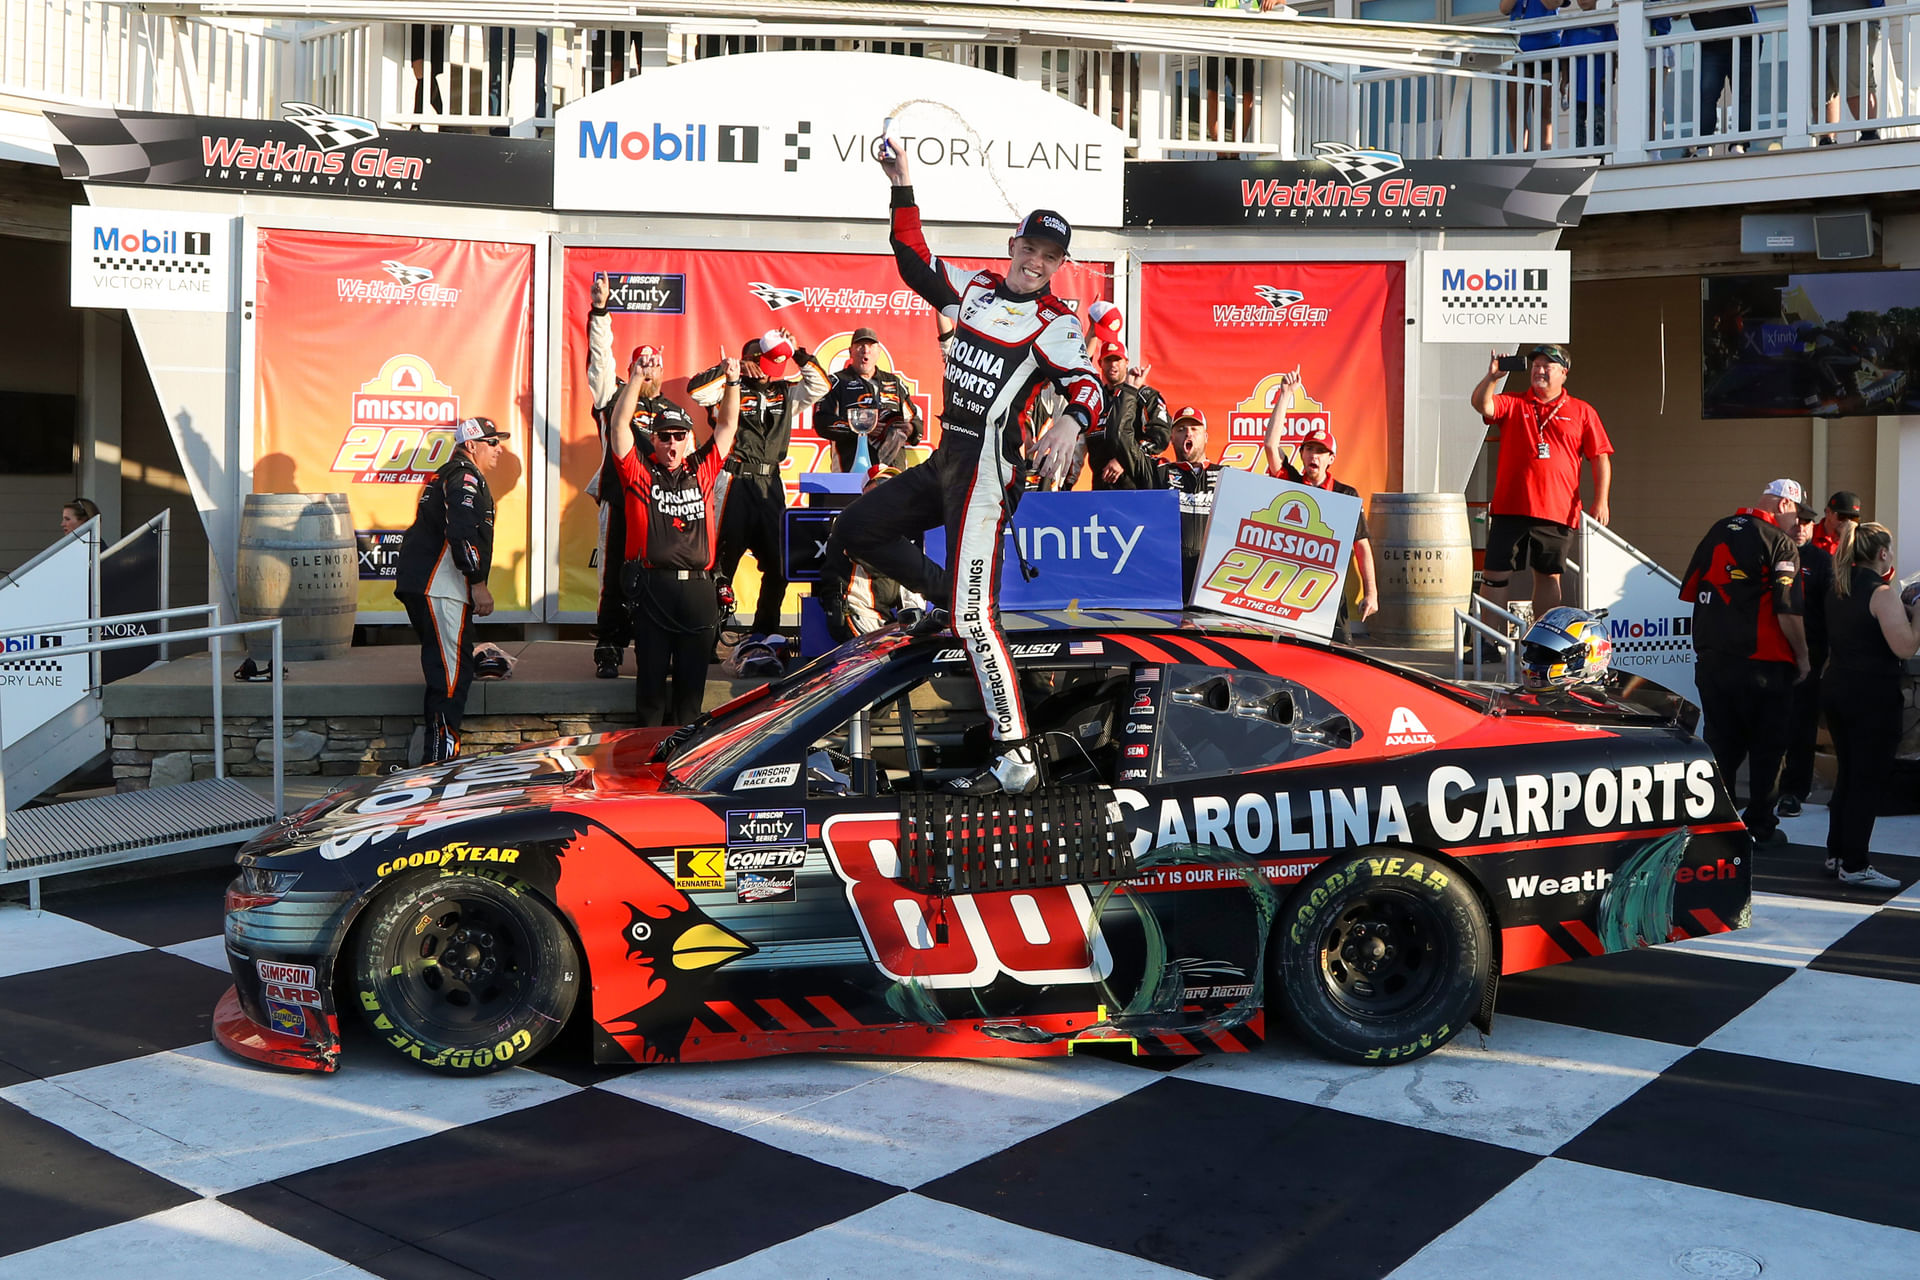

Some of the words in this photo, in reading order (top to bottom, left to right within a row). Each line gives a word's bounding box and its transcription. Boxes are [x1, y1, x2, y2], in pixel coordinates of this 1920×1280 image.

[580, 121, 706, 162] Mobil
[201, 134, 345, 175] Watkins
[351, 147, 424, 179] Glen
[1008, 140, 1102, 172] LANE
[204, 169, 419, 192] INTERNATIONAL
[1241, 178, 1371, 206] Watkins
[1378, 179, 1447, 207] Glen
[1244, 208, 1443, 218] INTERNATIONAL
[93, 226, 177, 255] Mobil
[93, 274, 165, 291] VICTORY
[168, 277, 211, 293] LANE
[337, 277, 414, 301] Watkins
[416, 283, 459, 303] Glen
[628, 275, 660, 285] NASCAR
[1442, 268, 1517, 292] Mobil
[338, 296, 458, 308] INTERNATIONAL
[609, 284, 671, 306] xfinity
[803, 287, 889, 309] Watkins
[626, 301, 652, 311] SERIES
[806, 307, 930, 317] INTERNATIONAL
[1213, 304, 1287, 323] Watkins
[1289, 306, 1329, 323] Glen
[1214, 319, 1327, 328] INTERNATIONAL
[1442, 313, 1505, 326] VICTORY
[1510, 313, 1548, 325] LANE
[948, 336, 1005, 380] ROLINA
[944, 362, 996, 399] ARPORTS
[357, 398, 455, 422] MISSION
[952, 391, 965, 408] Est.
[966, 400, 986, 416] 1997
[331, 427, 455, 471] 200
[361, 473, 377, 483] AT
[378, 473, 397, 483] THE
[398, 473, 425, 483] GLEN
[1003, 513, 1145, 575] inity
[1240, 524, 1335, 562] MISSION
[379, 567, 397, 576] SER
[1206, 552, 1336, 609] 200
[964, 558, 984, 622] BUILDINGS
[1231, 596, 1245, 606] AT
[1245, 598, 1265, 611] THE
[1266, 602, 1292, 617] GLEN
[1611, 617, 1669, 639] Mobil
[0, 634, 35, 653] bil
[1611, 654, 1659, 667] VICTORY
[1661, 652, 1691, 664] LANE
[28, 675, 63, 687] LANE
[984, 653, 1012, 735] COMMERCIAL
[1385, 733, 1436, 747] AXALTA
[1127, 746, 1145, 756] SEM
[742, 777, 767, 787] RACE
[768, 776, 788, 785] CAR
[755, 766, 791, 778] NASCAR
[755, 811, 784, 820] NASCAR
[1112, 785, 1413, 861] CAROLINA
[1427, 759, 1716, 843] CARPORTS
[739, 820, 794, 839] xfinity
[755, 834, 778, 842] SERIES
[376, 844, 520, 878] GOODYEAR
[728, 850, 805, 867] COMETIC
[676, 879, 724, 888] KENNAMETAL
[1169, 871, 1182, 884] IS
[1185, 868, 1214, 883] OUR
[1217, 866, 1254, 881] FIRST
[1258, 863, 1320, 879] PRIORITY
[1291, 857, 1449, 945] GOODYEAR
[260, 963, 311, 985] SIMPSON
[266, 983, 321, 1004] ARP
[271, 1011, 302, 1025] SUNOCO
